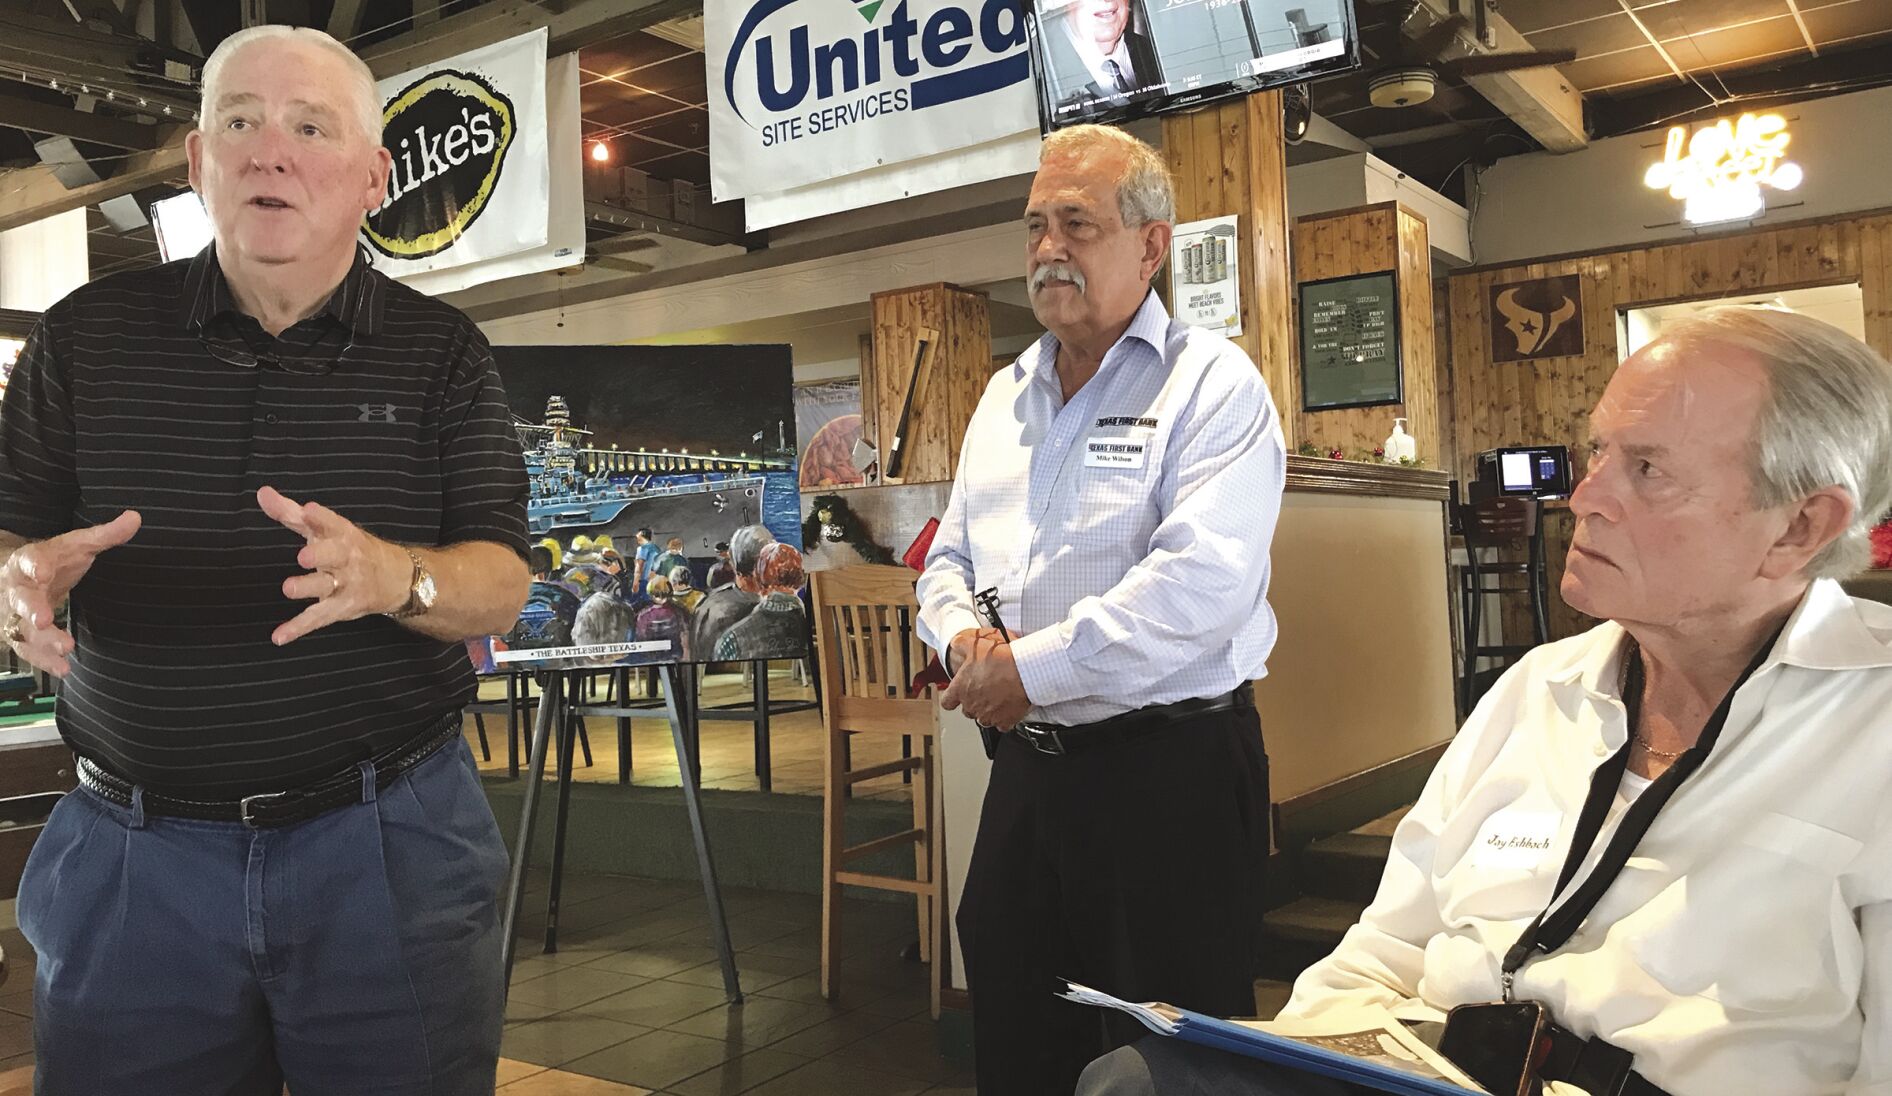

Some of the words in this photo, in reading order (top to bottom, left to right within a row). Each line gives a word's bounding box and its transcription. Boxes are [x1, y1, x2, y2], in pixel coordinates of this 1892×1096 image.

[755, 0, 1029, 113] United
[762, 116, 803, 147] SITE
[808, 88, 909, 135] SERVICES
[1118, 417, 1137, 426] FIRST
[1138, 417, 1158, 428] BANK
[1109, 444, 1126, 453] FIRST
[1126, 445, 1143, 454] BANK
[536, 649, 552, 658] THE
[555, 646, 607, 657] BATTLESHIP
[608, 643, 637, 653] TEXAS
[1487, 834, 1507, 850] Jay
[1508, 836, 1550, 849] Eshbach
